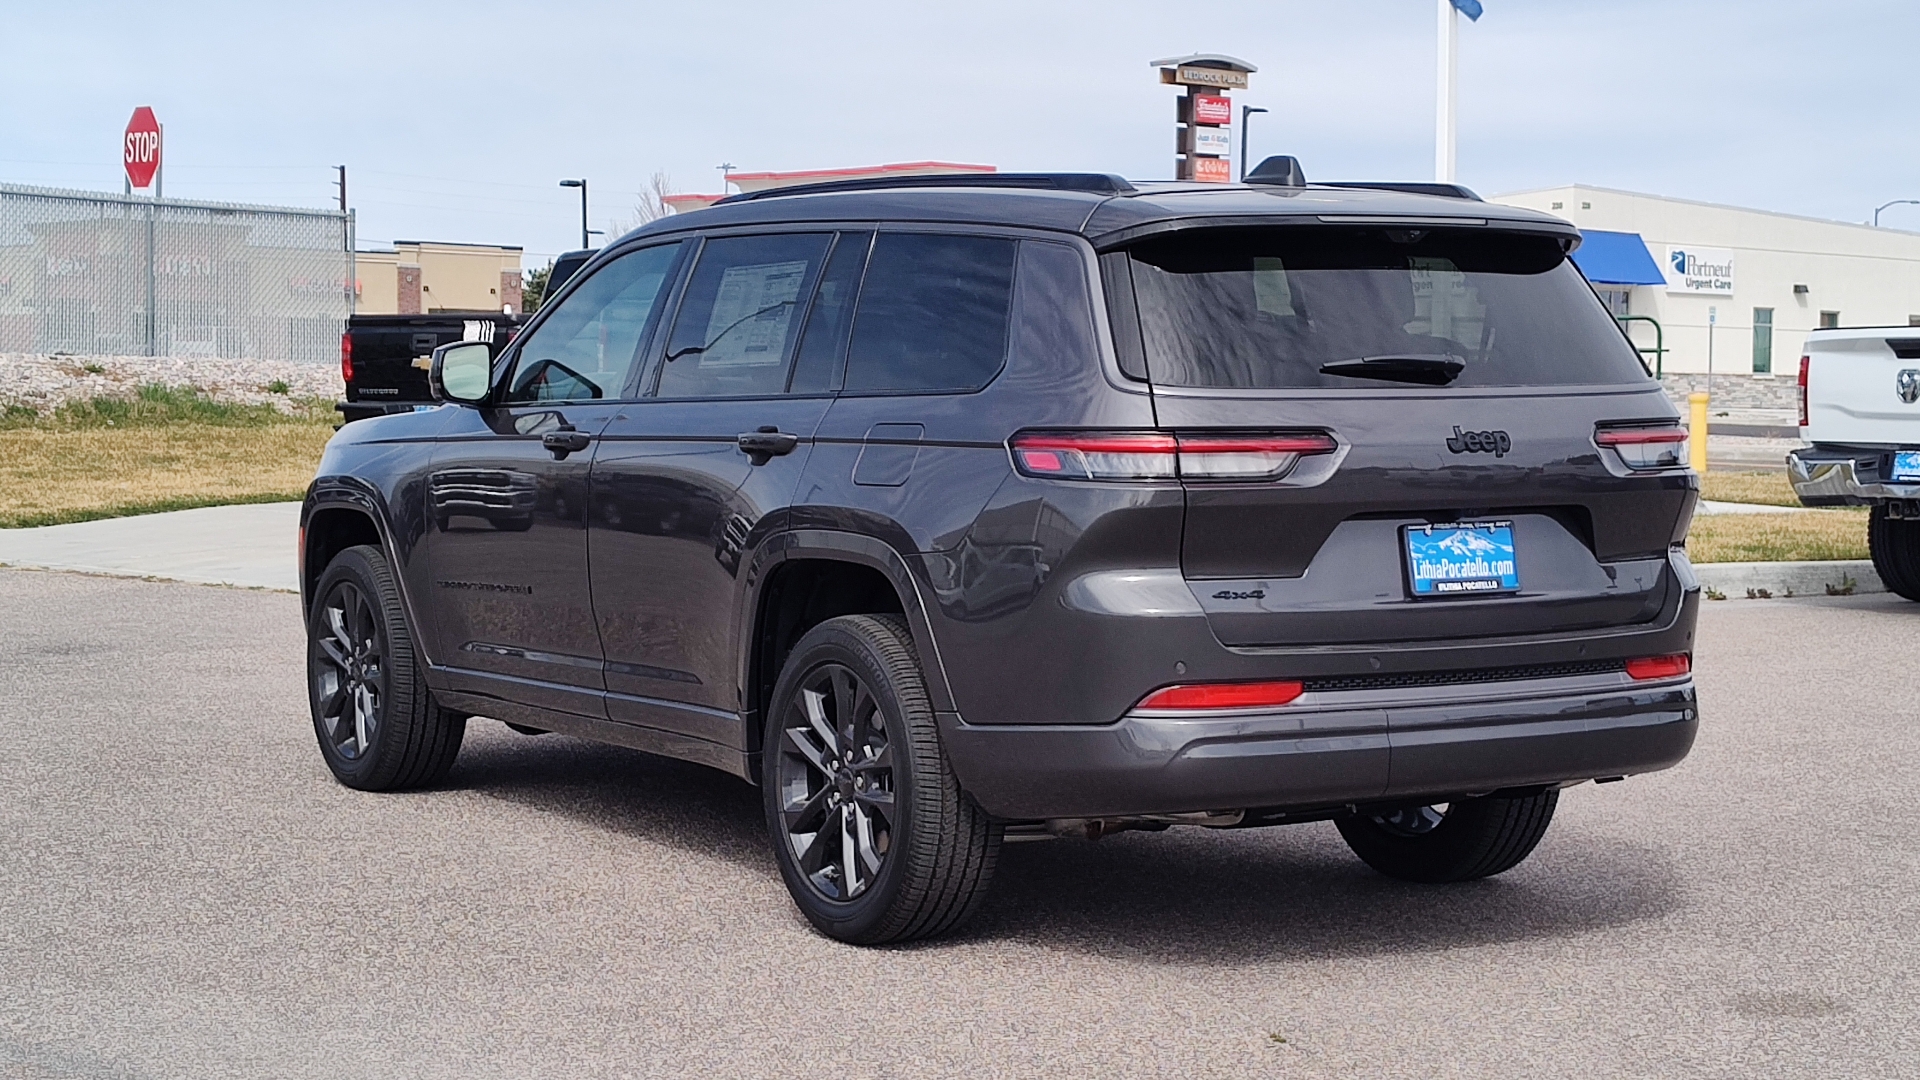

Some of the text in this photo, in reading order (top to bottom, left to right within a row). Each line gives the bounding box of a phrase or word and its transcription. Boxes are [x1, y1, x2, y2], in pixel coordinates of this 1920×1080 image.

[1183, 69, 1246, 85] BEDROCK PLAZA
[125, 131, 158, 163] STOP
[1687, 254, 1732, 278] Portneuf
[1685, 277, 1732, 290] Urgent Care
[1446, 425, 1511, 458] Jeep
[1413, 557, 1514, 580] LithiaPocatello.com
